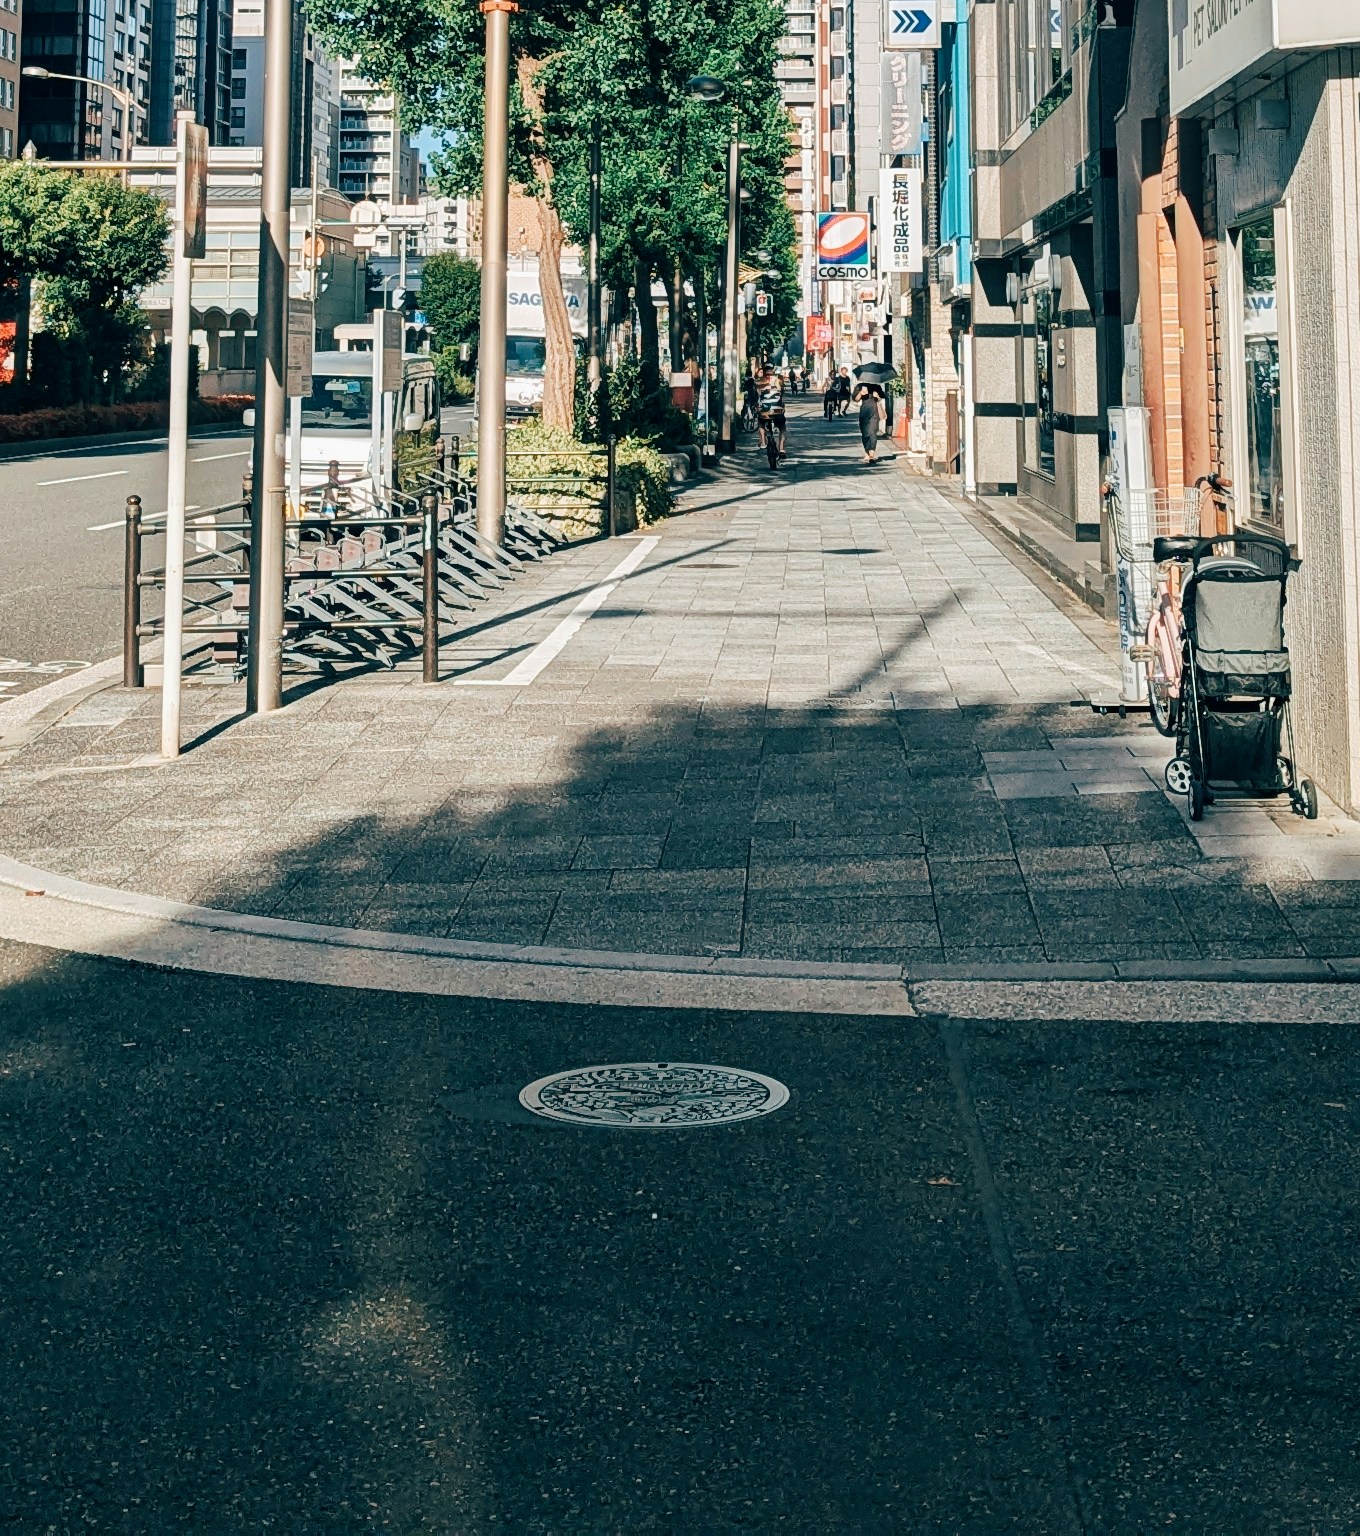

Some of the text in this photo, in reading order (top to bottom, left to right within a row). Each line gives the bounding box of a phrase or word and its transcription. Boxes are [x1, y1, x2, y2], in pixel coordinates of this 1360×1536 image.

[1193, 3, 1205, 49] PET
[890, 55, 912, 152] クリーニング
[892, 173, 910, 253] 長堀化成品
[819, 266, 869, 279] COSMO
[508, 292, 580, 308] SAGA
